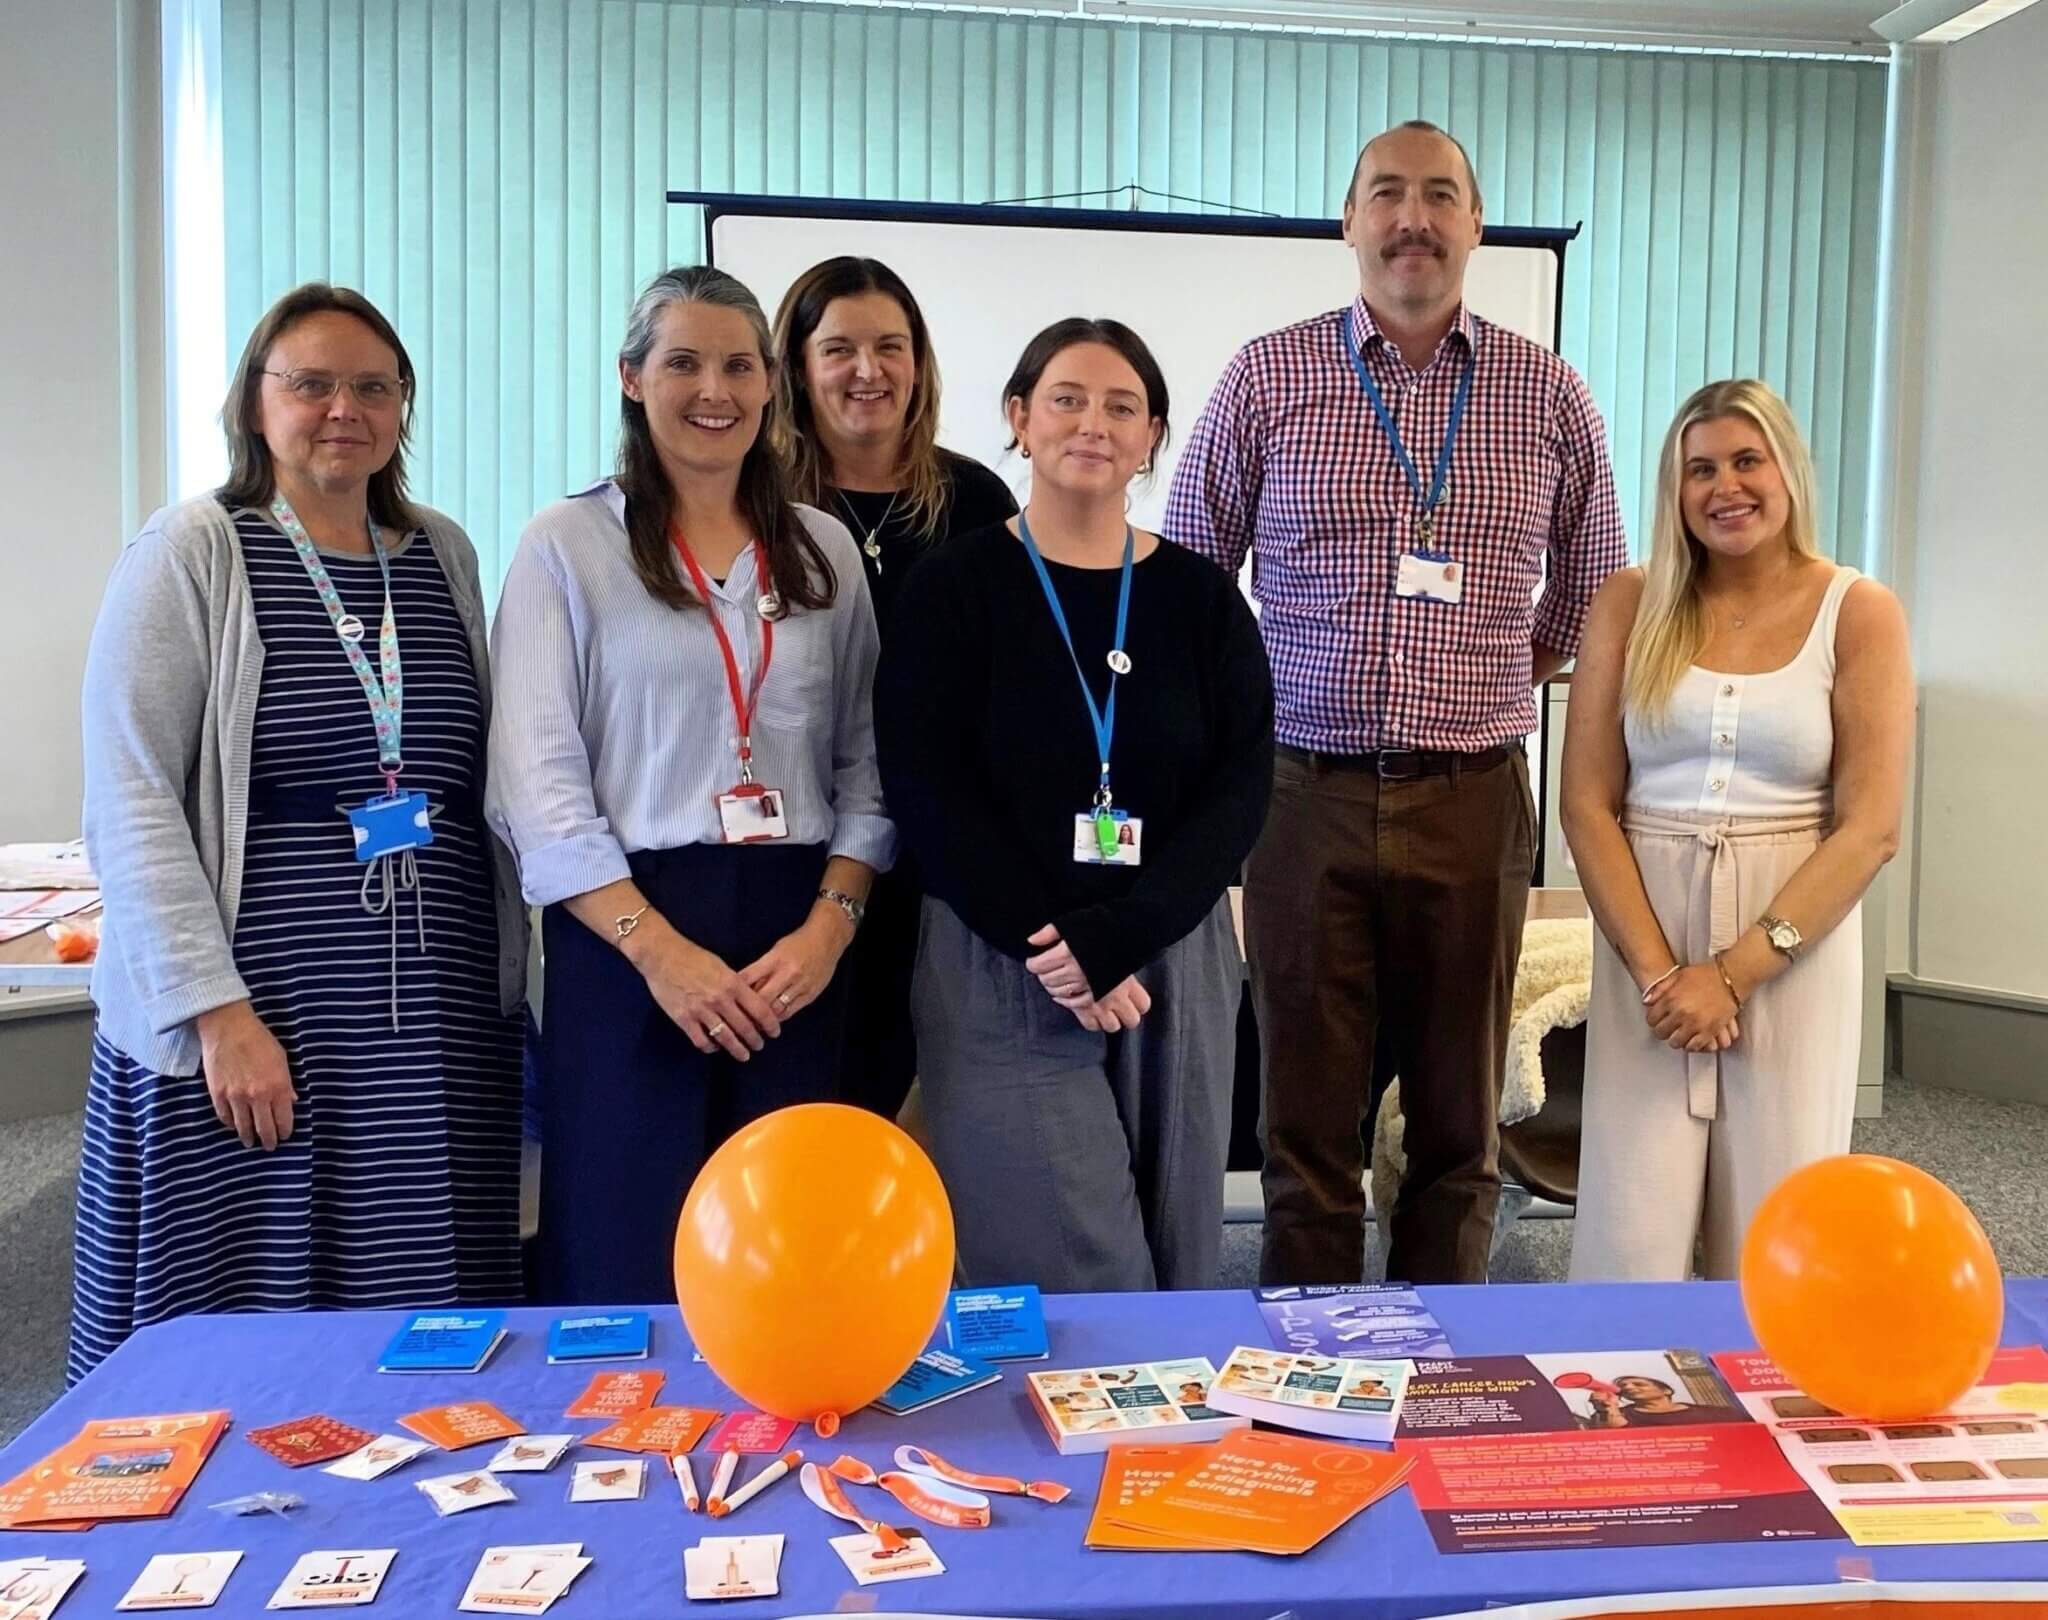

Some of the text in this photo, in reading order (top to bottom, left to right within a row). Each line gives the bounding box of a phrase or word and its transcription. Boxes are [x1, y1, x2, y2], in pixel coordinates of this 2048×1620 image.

[1737, 1358, 1771, 1366] TOU
[1443, 1380, 1496, 1390] CANCER
[1750, 1377, 1793, 1386] CHEC
[1405, 1387, 1484, 1396] MPAIGNING
[1218, 1453, 1301, 1474] Here for
[1123, 1469, 1176, 1479] Here
[1207, 1462, 1318, 1489] everything
[66, 1478, 163, 1490] SUPPORT
[1184, 1479, 1255, 1498] brings
[1214, 1474, 1316, 1497] diagnosis
[40, 1485, 173, 1498] AWARENESS
[47, 1495, 152, 1506] SURVIVAL
